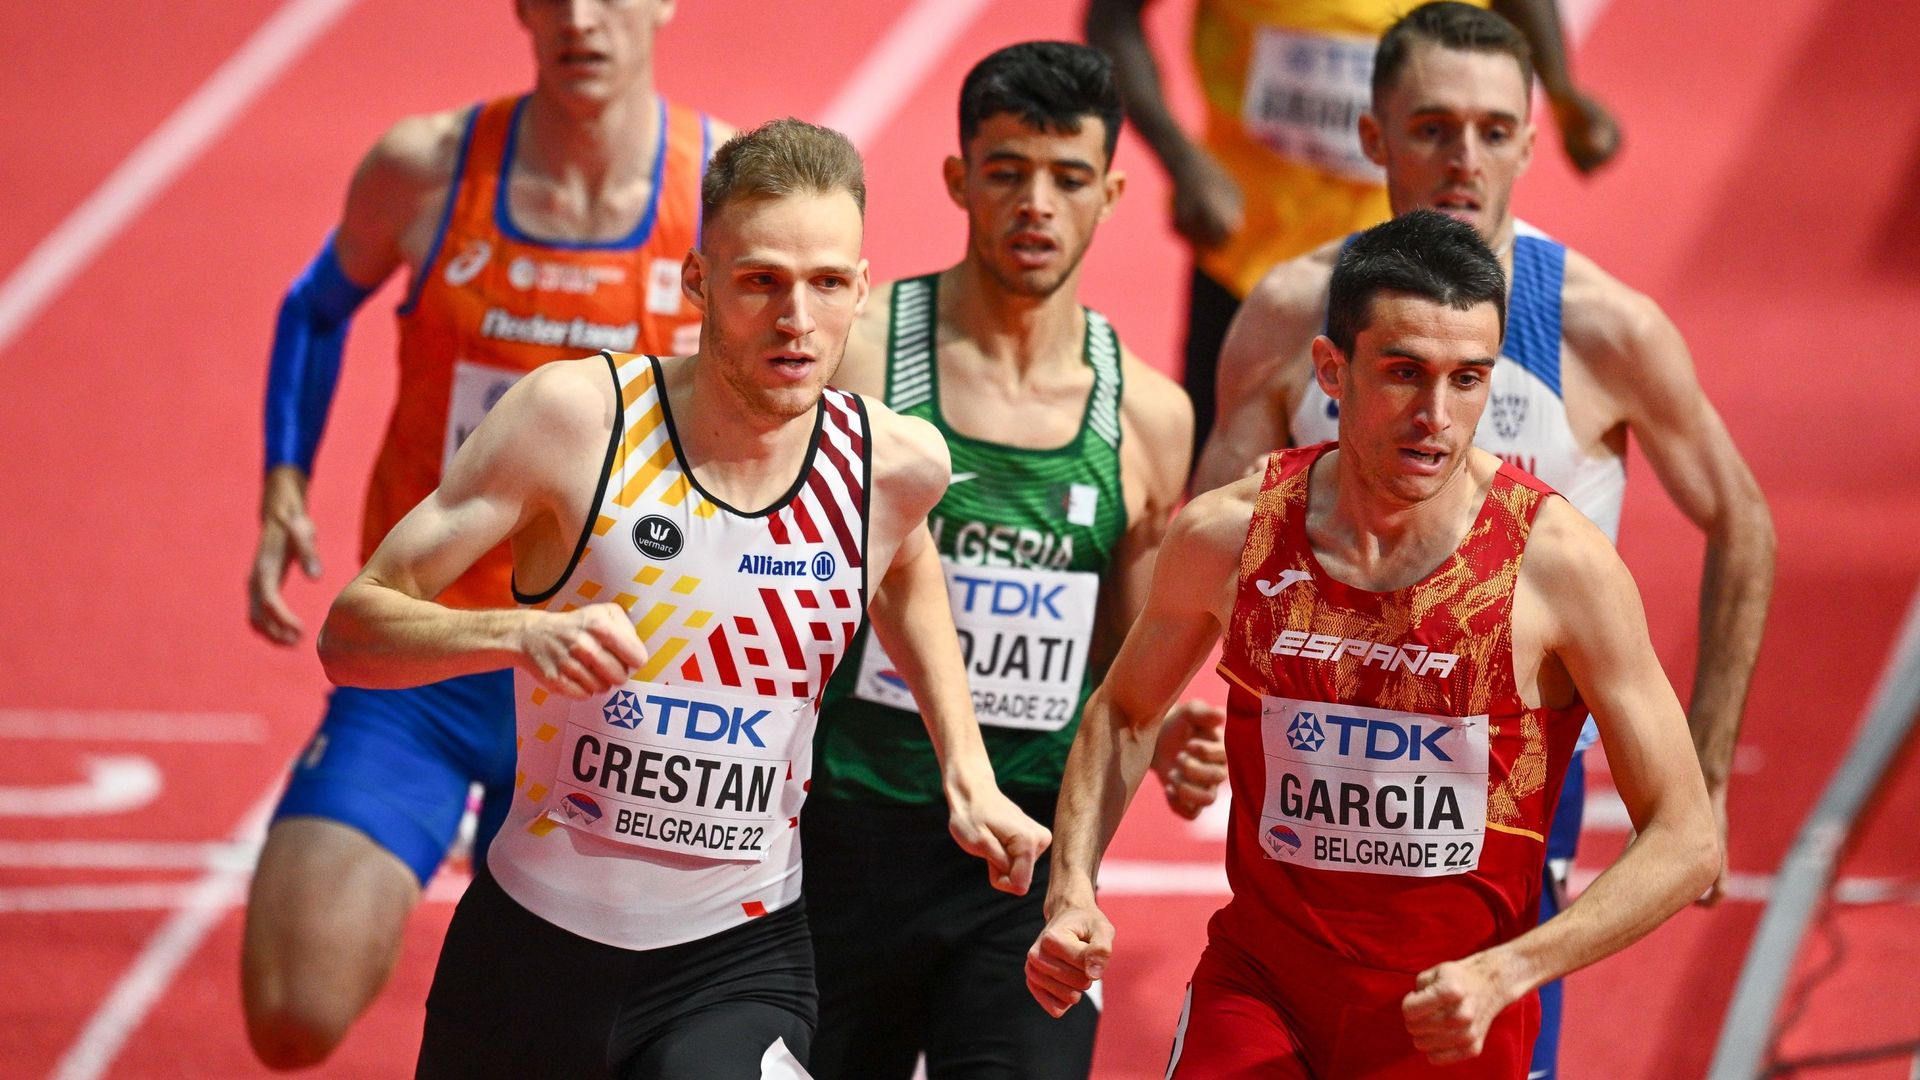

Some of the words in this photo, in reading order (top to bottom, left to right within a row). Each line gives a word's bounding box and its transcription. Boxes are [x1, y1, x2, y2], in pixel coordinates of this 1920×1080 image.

[639, 537, 674, 554] vermarc
[737, 554, 807, 577] Allianz
[953, 575, 1068, 620] TDK
[1269, 630, 1461, 679] ESPAÑA
[646, 694, 773, 748] TDK
[1043, 697, 1070, 721] 22
[1325, 714, 1455, 763] TDK
[572, 734, 777, 813] CRESTAN
[1279, 772, 1465, 831] GARCÍA
[614, 809, 739, 851] BELGRADE
[738, 827, 765, 851] 22
[1314, 835, 1437, 868] BELGRADE
[1444, 842, 1475, 867] 22
